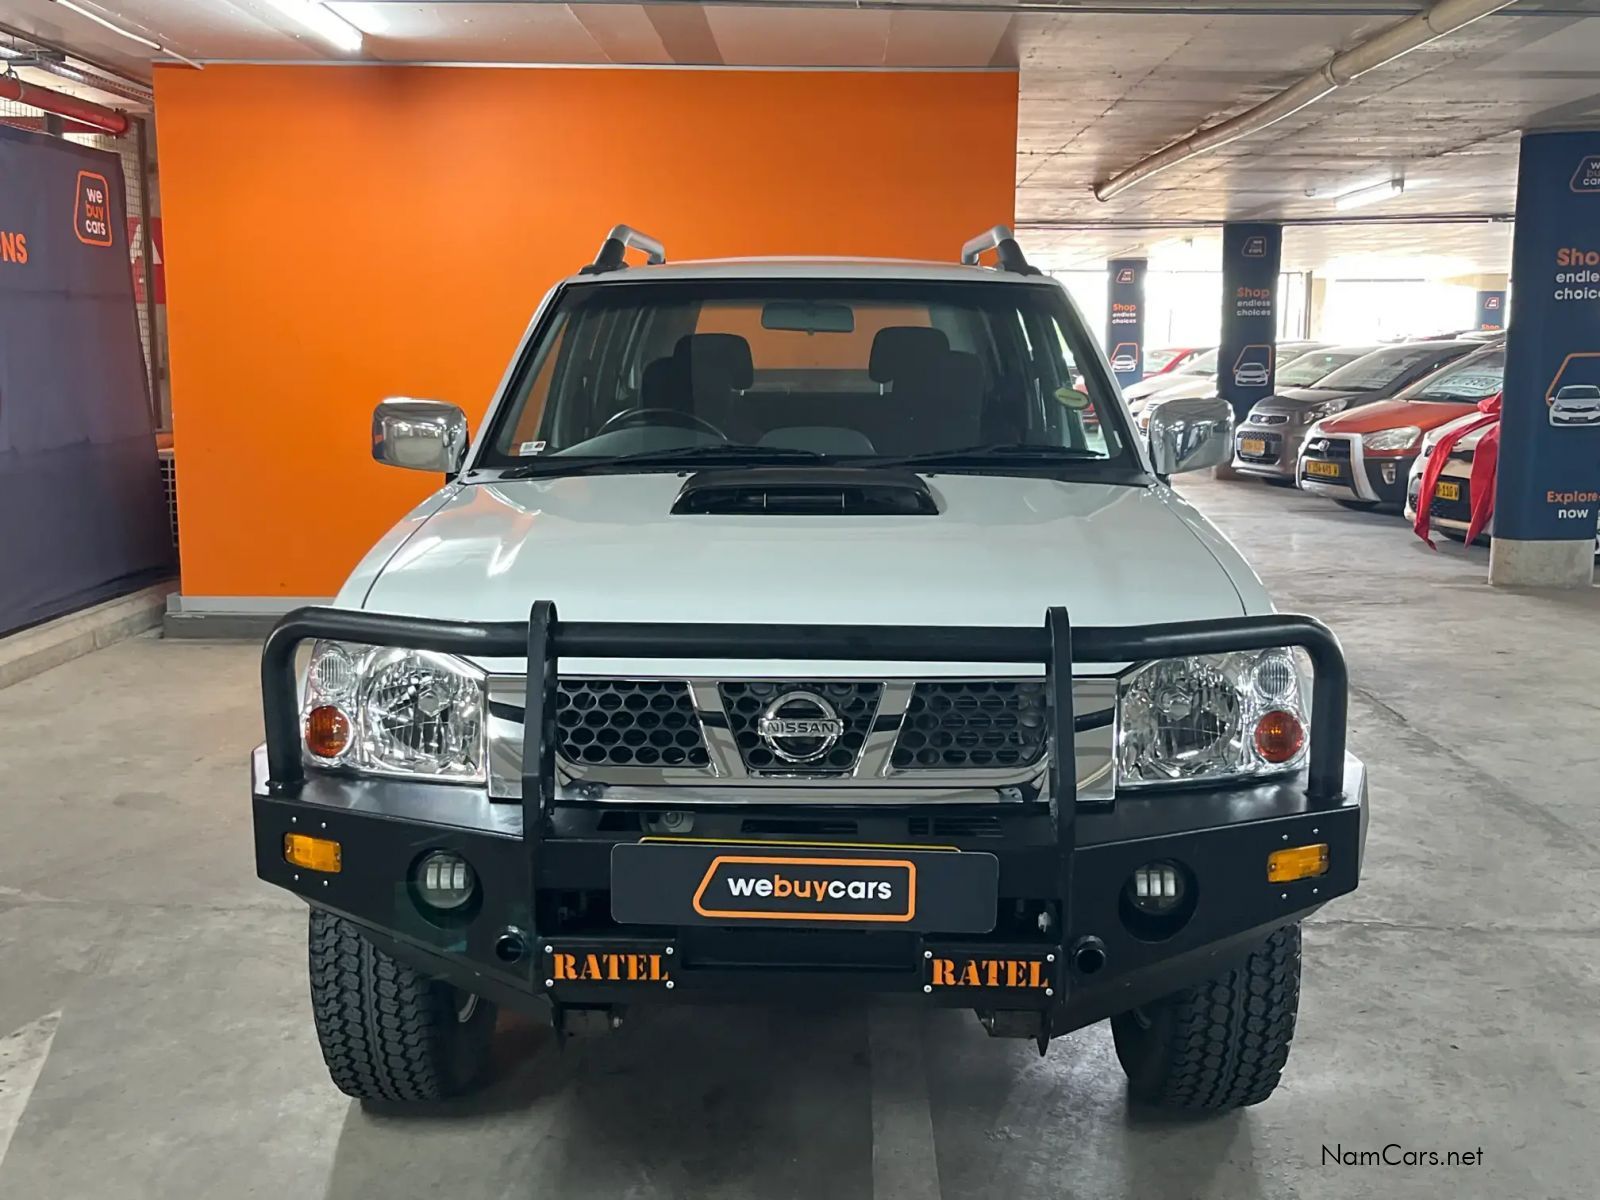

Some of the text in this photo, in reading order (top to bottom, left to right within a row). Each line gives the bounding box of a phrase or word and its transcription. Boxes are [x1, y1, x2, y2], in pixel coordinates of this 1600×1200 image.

[86, 187, 103, 204] we
[85, 200, 104, 222] buy
[86, 219, 106, 236] cars
[0, 231, 28, 265] NS
[1556, 247, 1600, 266] Sho
[1237, 287, 1270, 299] Shop
[1554, 287, 1600, 300] choic
[1112, 303, 1136, 312] Shop
[1237, 299, 1271, 307] endless
[1236, 309, 1271, 317] choices
[1546, 490, 1598, 505] Explore
[1558, 508, 1589, 519] now
[766, 722, 834, 734] NISSAN
[727, 873, 892, 902] webuycars
[552, 953, 670, 981] RATEL
[931, 958, 1049, 988] RATEL
